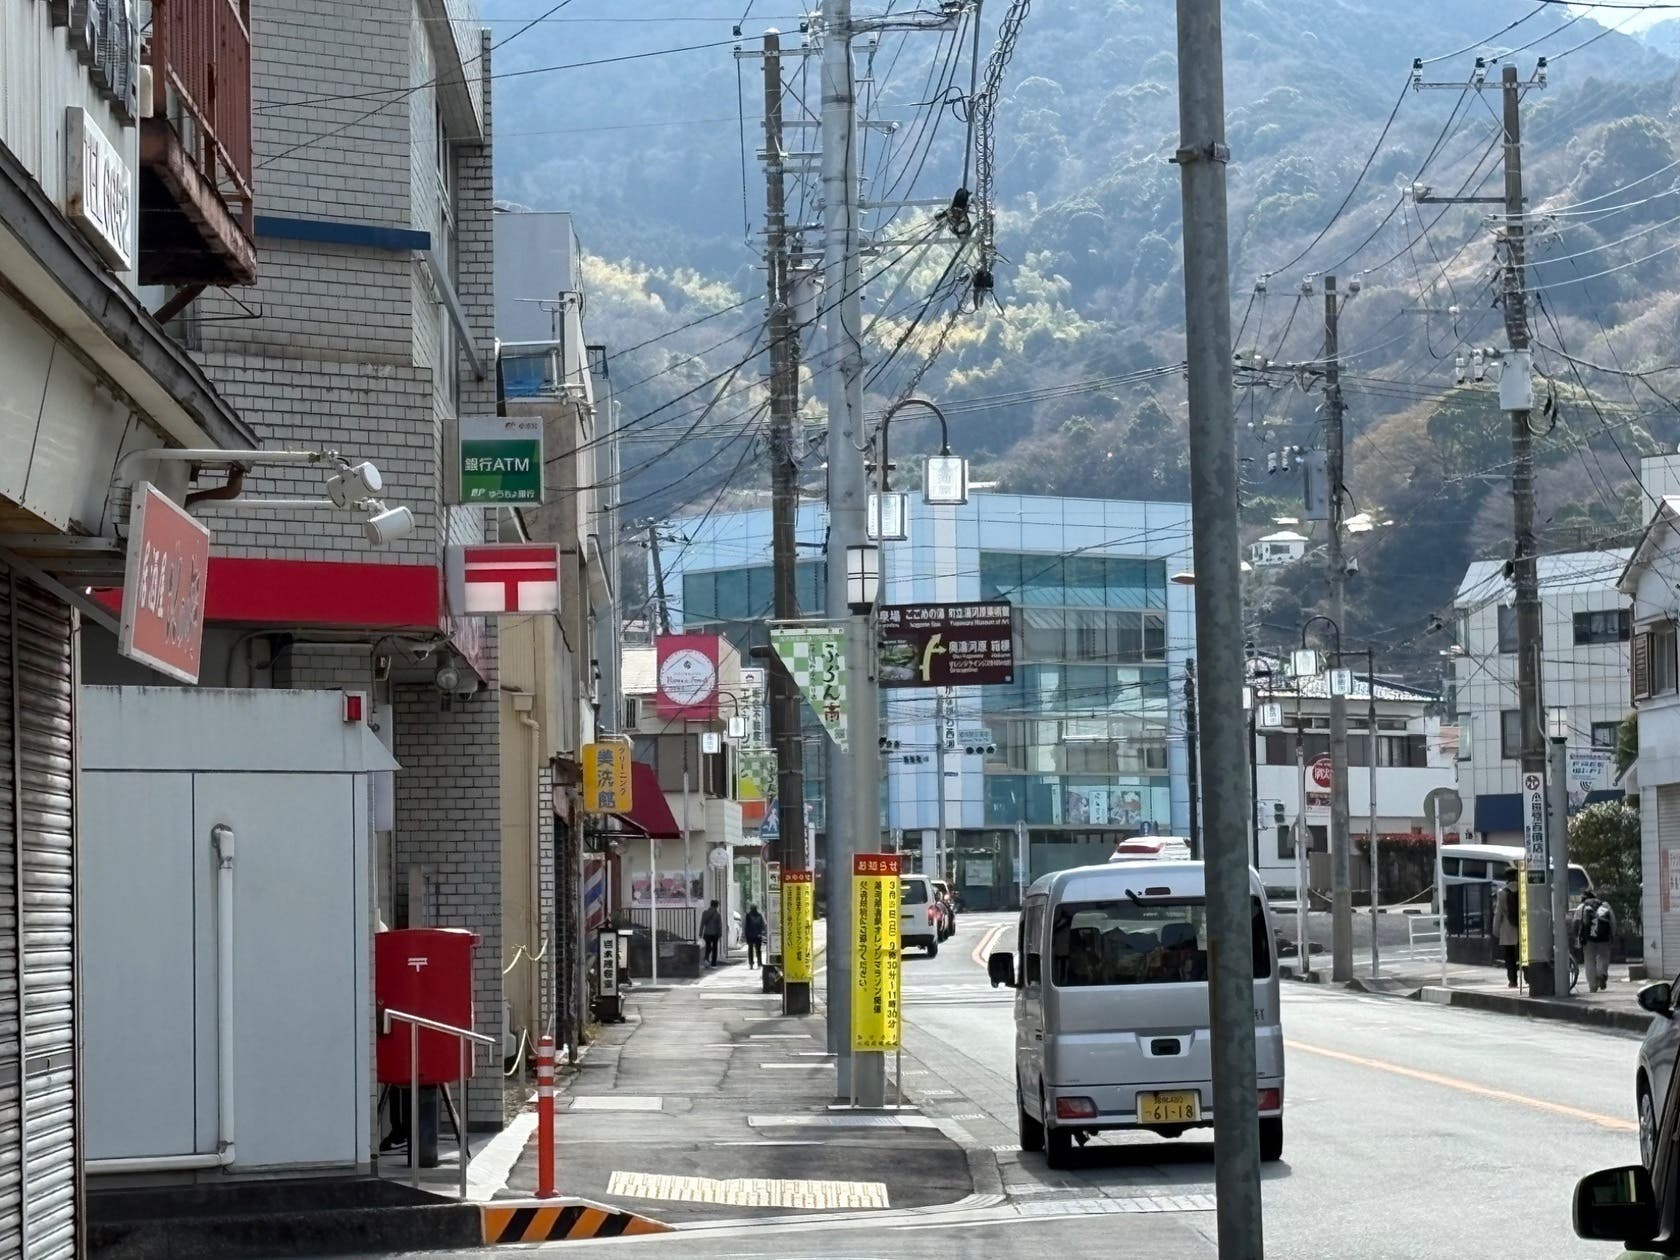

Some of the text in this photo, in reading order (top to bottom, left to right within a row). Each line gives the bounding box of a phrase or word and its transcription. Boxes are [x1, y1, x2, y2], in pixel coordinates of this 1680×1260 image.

[464, 457, 530, 472] 銀行ATM
[488, 489, 535, 498] ゆうちょ銀行
[597, 749, 615, 808] 美洗館
[1314, 767, 1331, 779] 消火
[858, 861, 898, 871] お知らせ
[1154, 1105, 1193, 1120] 61-18
